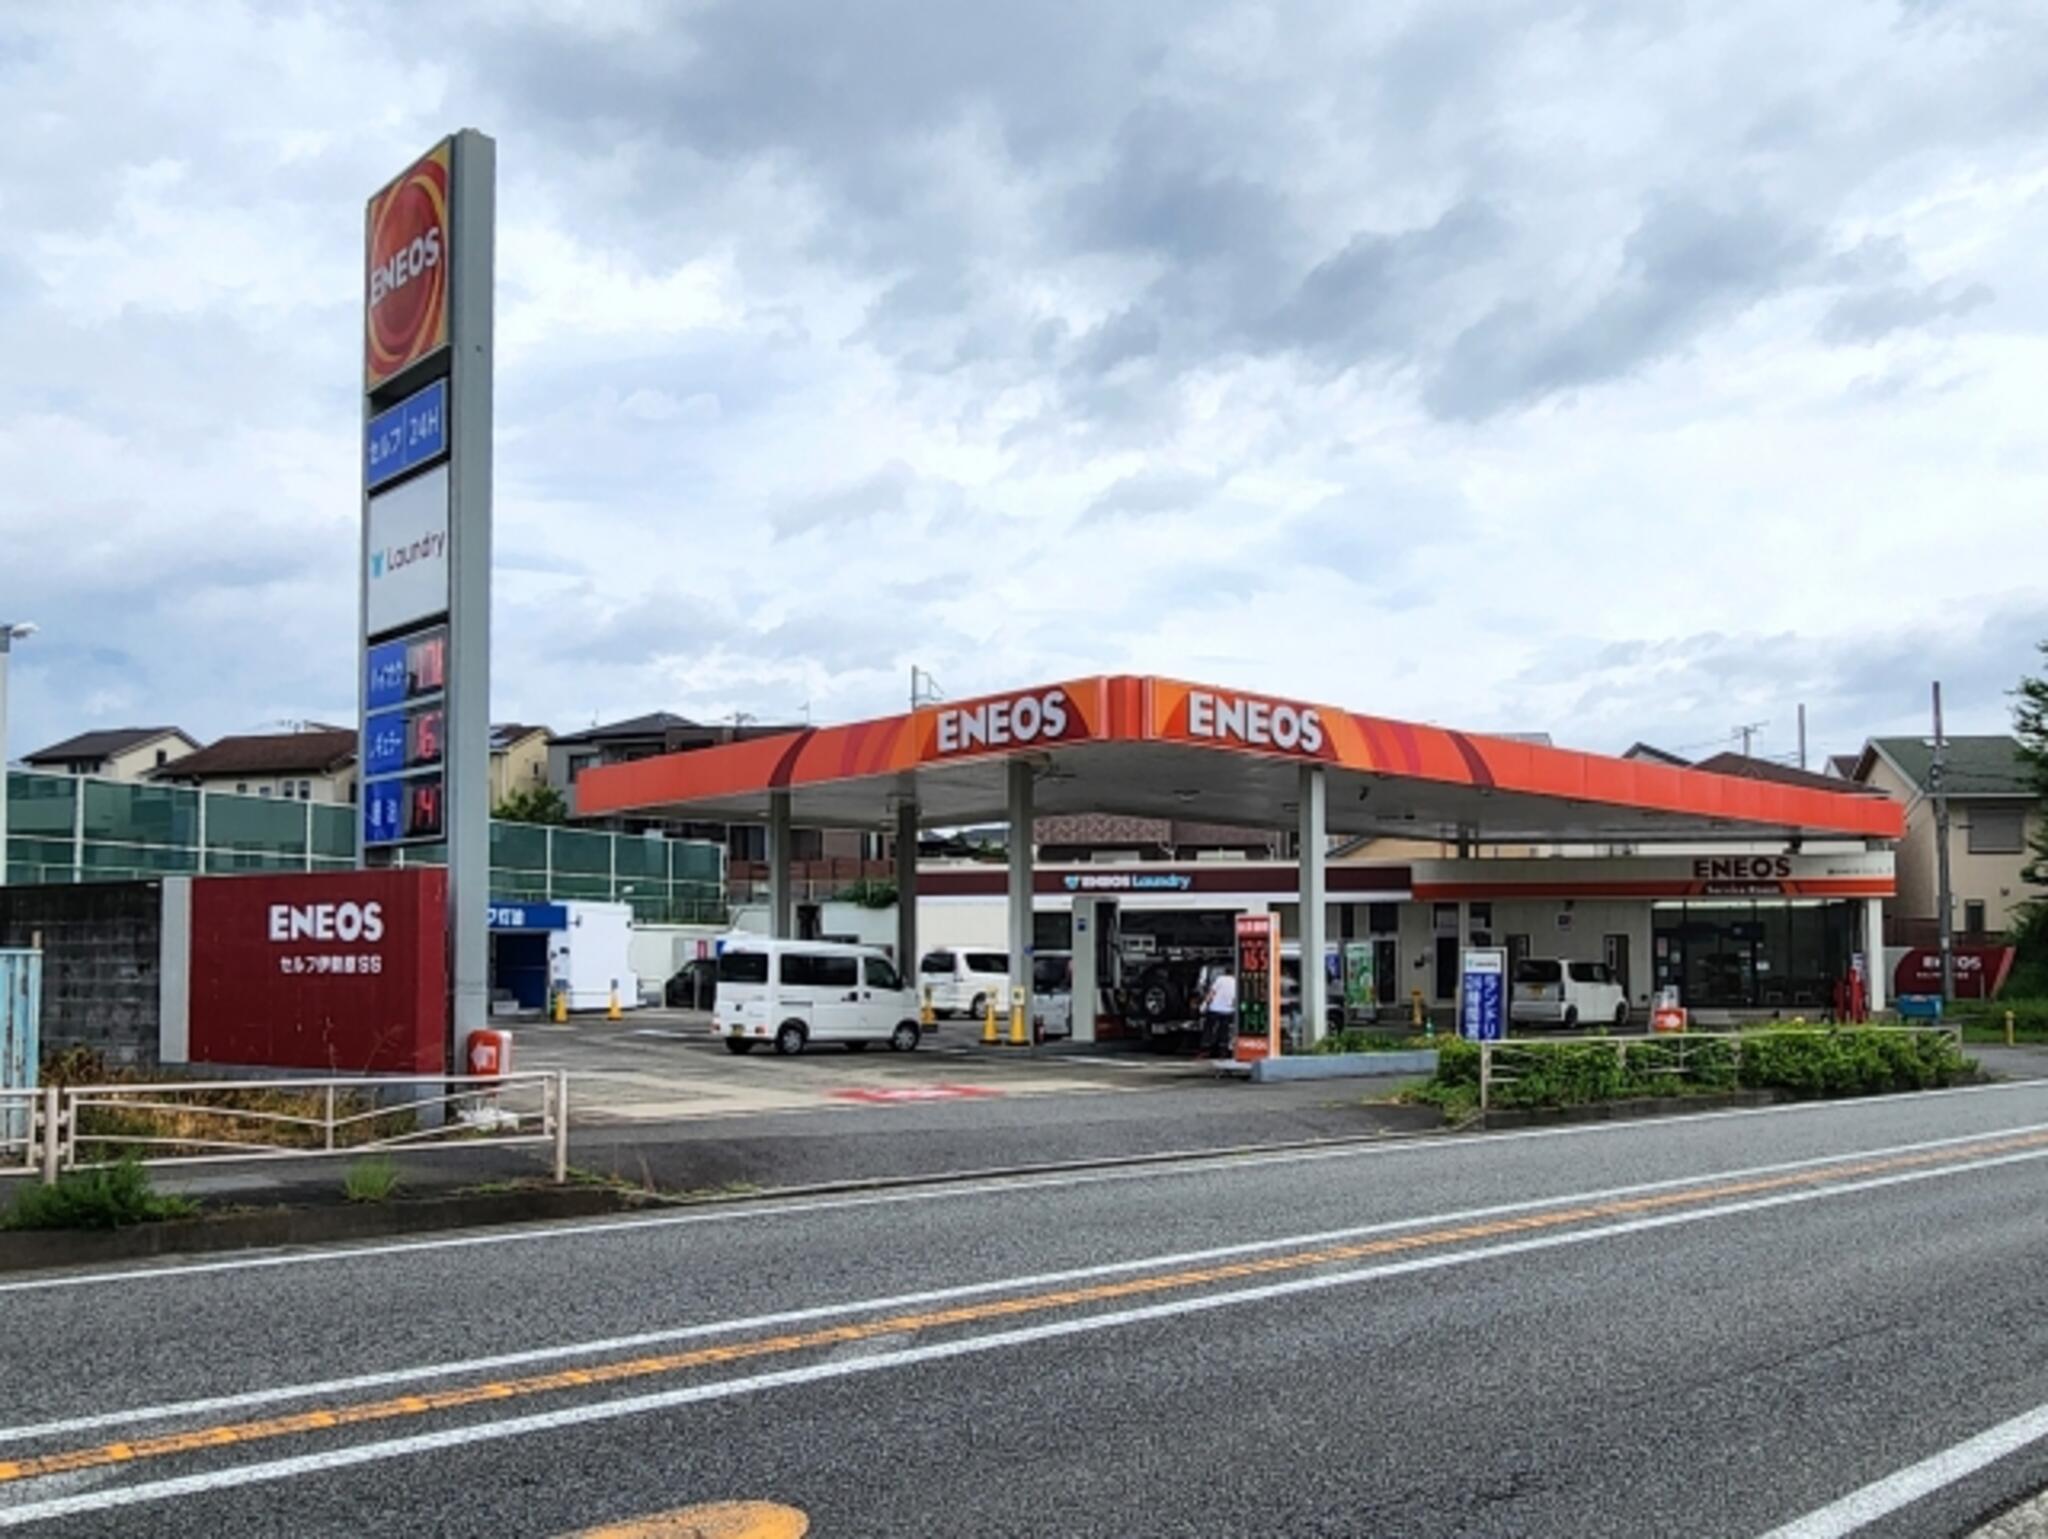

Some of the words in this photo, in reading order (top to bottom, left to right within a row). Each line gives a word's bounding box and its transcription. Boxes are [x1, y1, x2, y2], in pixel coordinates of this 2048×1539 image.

[370, 227, 440, 304] ENEOS
[409, 406, 439, 446] 24H
[387, 530, 445, 572] Laundry
[937, 691, 1067, 752] ENEOS
[1189, 691, 1323, 753] ENEOS
[1132, 873, 1191, 890] Laundry
[1692, 856, 1791, 878] ENEOS
[269, 901, 384, 942] ENEOS
[1923, 956, 1982, 971] ENOS
